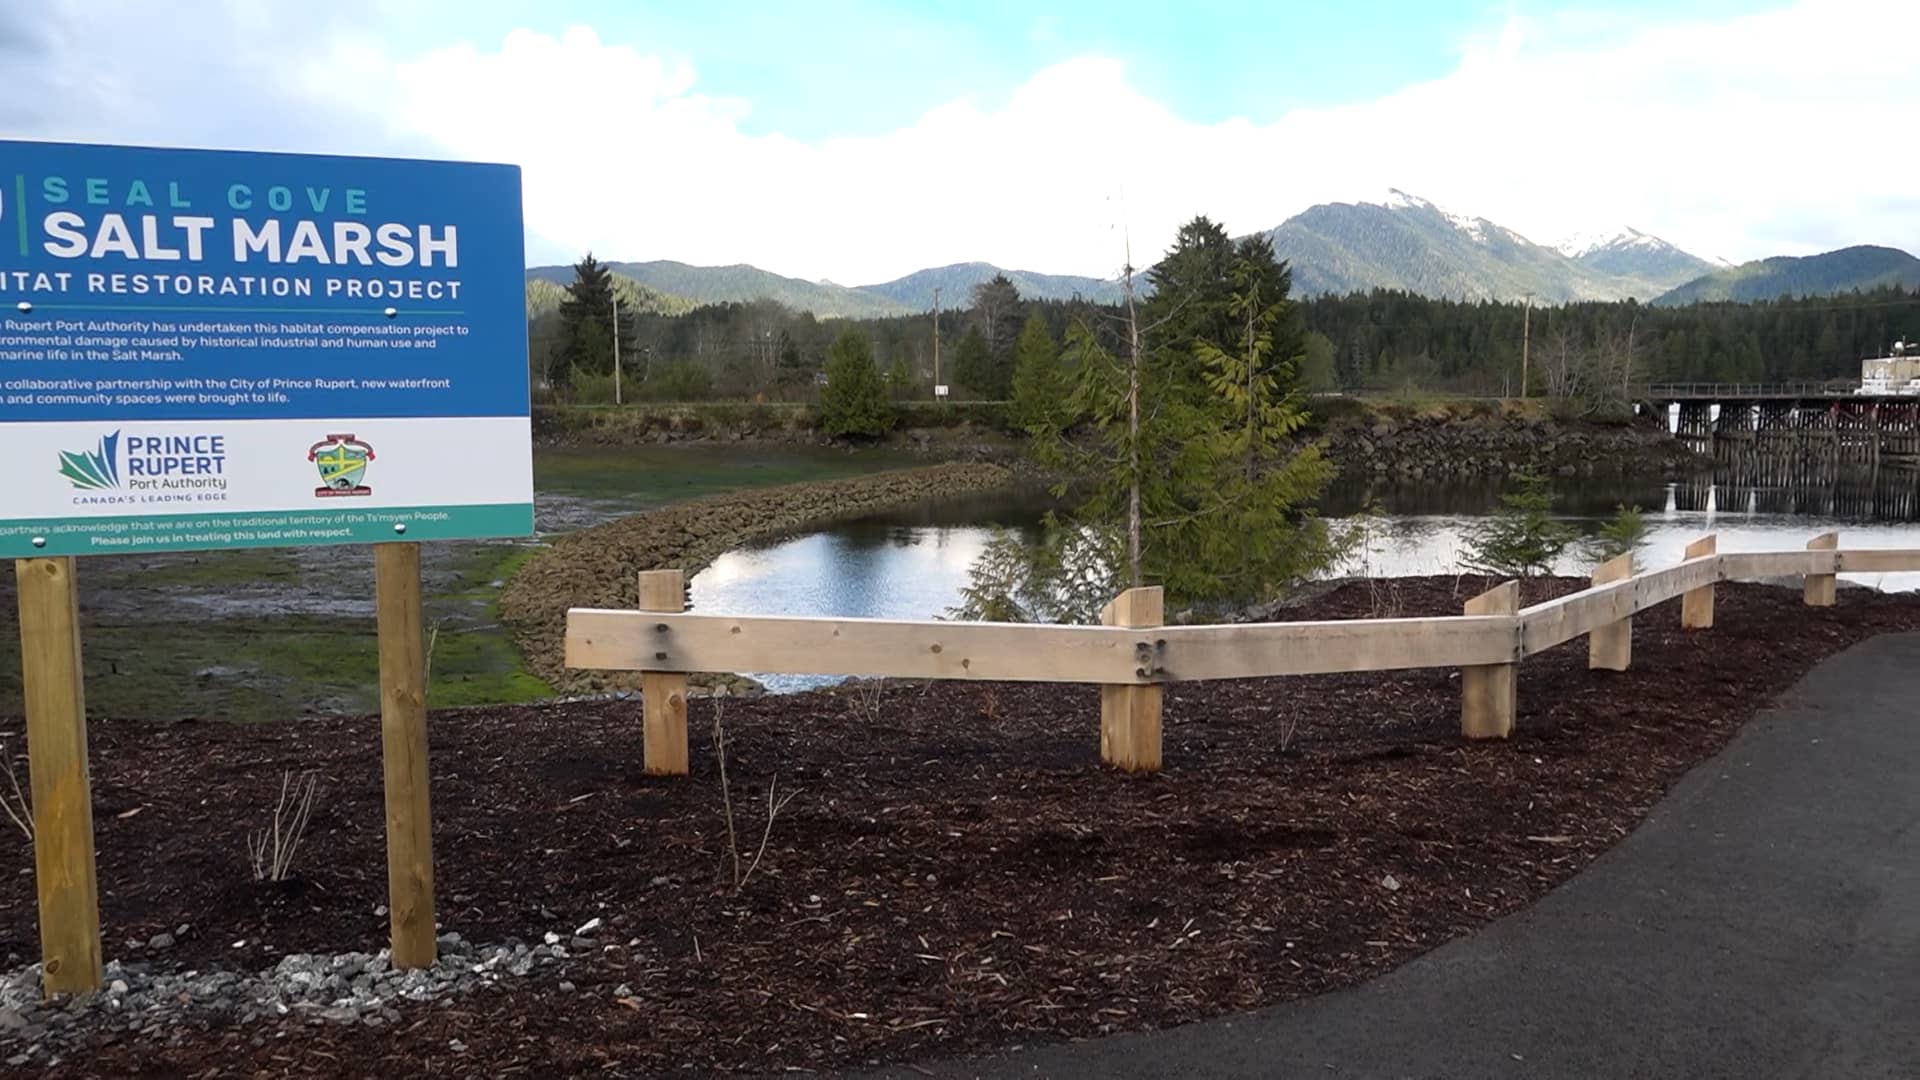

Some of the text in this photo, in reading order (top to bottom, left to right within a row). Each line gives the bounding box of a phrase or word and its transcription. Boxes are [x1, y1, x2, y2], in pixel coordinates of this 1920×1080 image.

[42, 176, 367, 215] SEAL COVE
[43, 211, 459, 268] SALT MARSH
[88, 273, 312, 298] RESTORATION
[327, 278, 462, 300] PROJECT
[5, 320, 469, 337] Rupert Port Authority has undertaken this habitat compensation project to
[75, 336, 129, 349] damage
[131, 336, 178, 347] caused
[182, 336, 197, 348] by
[201, 336, 257, 348] historical
[261, 337, 318, 348] industrial
[321, 338, 344, 348] and
[347, 338, 388, 348] human
[390, 339, 412, 349] use
[414, 338, 436, 349] and
[48, 350, 68, 360] life
[71, 350, 84, 360] in
[86, 350, 109, 361] the
[112, 350, 137, 361] Salt
[141, 351, 184, 362] Marsh.
[5, 377, 451, 391] collaborative partnership with the City of Prince Rupert, new waterfront
[7, 392, 290, 406] and community spaces were brought to life.
[127, 435, 225, 455] PRINCE
[128, 455, 225, 476] RUPERT
[129, 477, 227, 490] Port Authority
[72, 493, 227, 505] CANADA'S LEADING EDGE
[53, 521, 128, 534] acknowledge
[130, 521, 154, 531] that
[157, 521, 173, 531] we
[176, 520, 193, 530] are
[196, 520, 210, 529] on
[212, 518, 231, 528] the
[233, 516, 287, 527] traditional
[289, 514, 332, 527] territory
[335, 514, 346, 524] of
[347, 514, 364, 523] the
[91, 527, 353, 546] Please join us in treating this land with respect.
